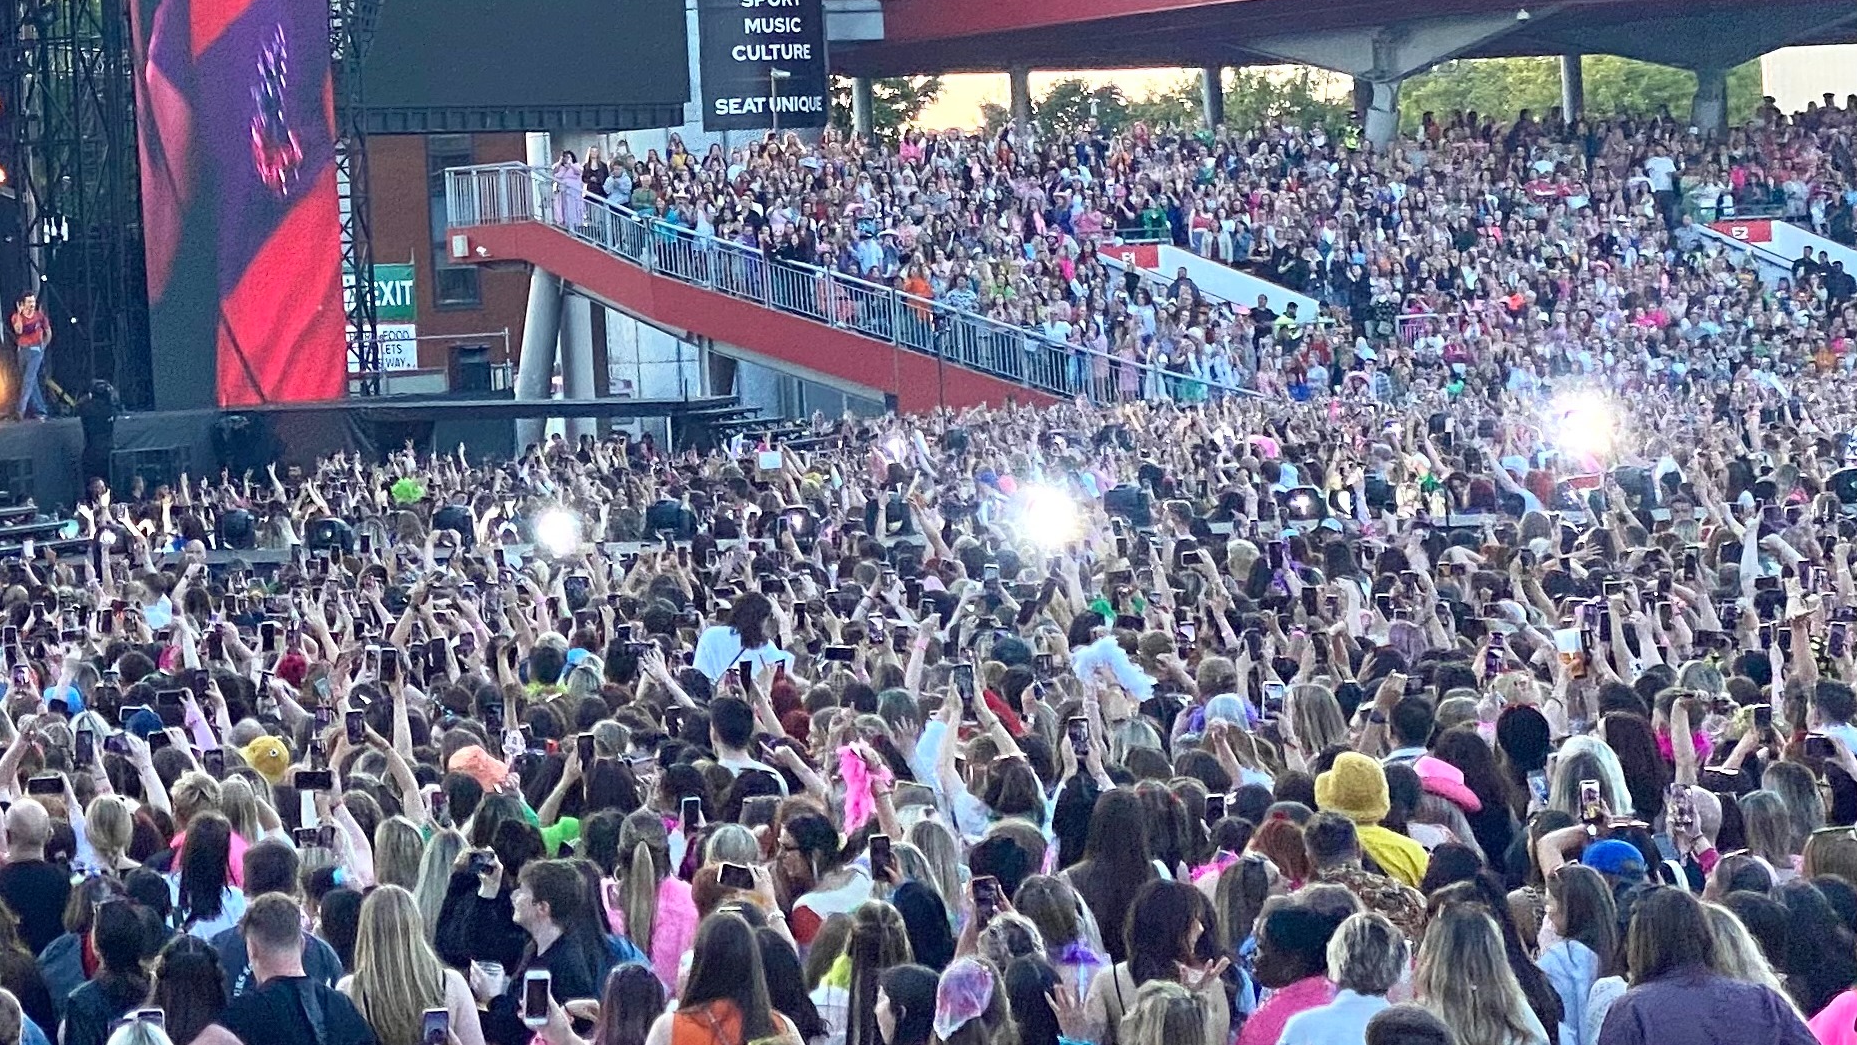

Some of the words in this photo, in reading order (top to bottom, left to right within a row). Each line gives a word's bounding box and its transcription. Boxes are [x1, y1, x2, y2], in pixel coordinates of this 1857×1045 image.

[744, 17, 801, 34] MUSIC
[731, 43, 812, 61] CULTURE
[715, 97, 766, 115] SEAT
[769, 96, 823, 113] UNIQUE
[373, 280, 413, 307] EXIT
